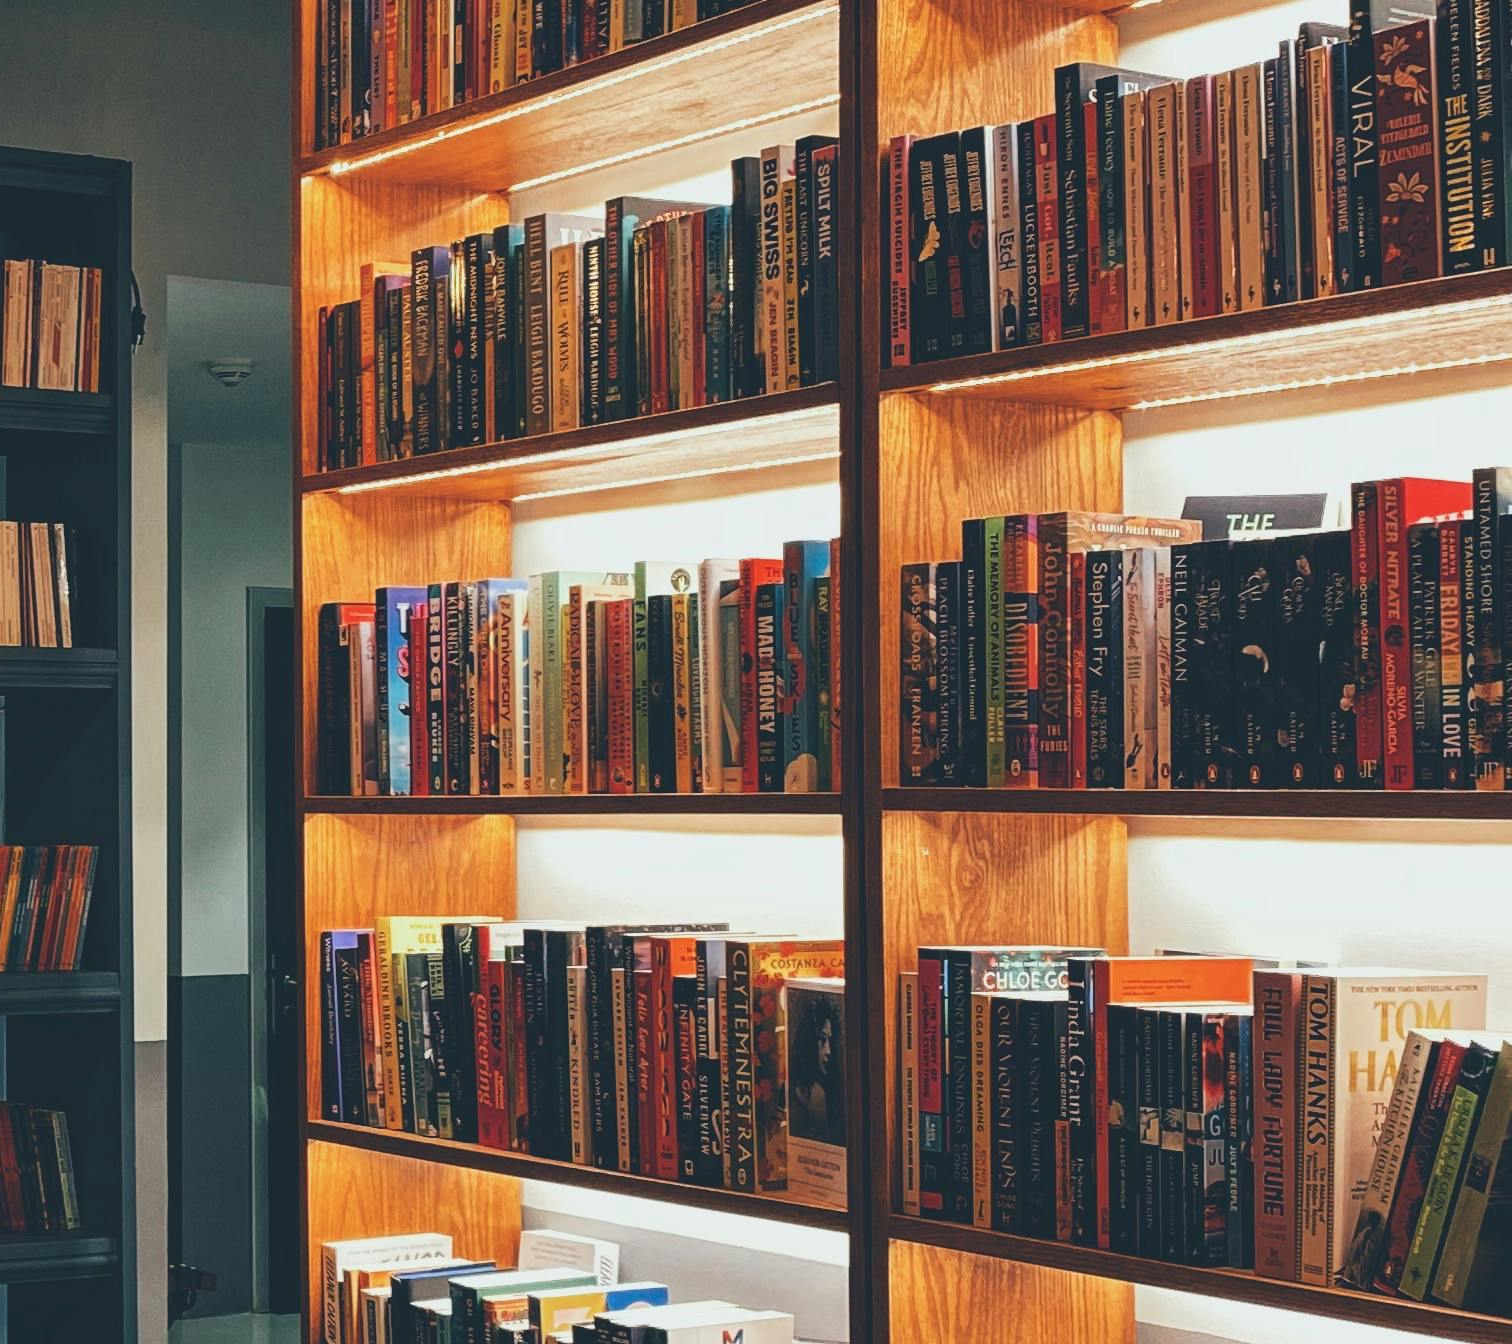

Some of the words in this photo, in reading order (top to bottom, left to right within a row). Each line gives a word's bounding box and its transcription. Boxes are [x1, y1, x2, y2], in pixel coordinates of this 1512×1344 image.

[1352, 76, 1375, 177] VIRAL
[763, 159, 777, 193] BIG
[1445, 117, 1476, 252] INSTITUTION
[529, 221, 541, 259] HELL
[764, 202, 779, 280] SWISS
[1024, 205, 1037, 317] LUCKENBOOTH
[530, 263, 542, 294] BENT
[531, 305, 543, 348] LEIGH
[531, 351, 544, 415] BARDUGO
[1226, 513, 1274, 531] THE
[1384, 487, 1397, 544] SILVER
[1479, 481, 1491, 559] UNTAMED
[990, 560, 998, 618] MEMORY
[1044, 542, 1062, 602] John
[1092, 562, 1109, 638] Stephen
[1176, 555, 1187, 596] NEIL
[1387, 550, 1400, 620] NITRATE
[1481, 564, 1492, 614] SHORE
[430, 597, 441, 701] BRIDGE
[446, 597, 458, 666] KILLINGLY
[758, 615, 775, 659] MAD
[991, 622, 998, 637] OF
[1175, 604, 1187, 681] GAIMAN
[1441, 586, 1460, 655] FRIDAY
[500, 615, 511, 721] Anniversary
[991, 640, 999, 702] ANIMALS
[1005, 602, 1028, 720] DISOBEDIENT
[1043, 610, 1063, 716] Connolly
[1089, 646, 1108, 677] Fry
[759, 670, 775, 733] HONEY
[1444, 689, 1460, 706] IN
[1443, 714, 1460, 758] LOVE
[984, 972, 1039, 990] CHLOE
[1069, 980, 1085, 1048] Linda
[1263, 988, 1283, 1041] FOUL
[1309, 984, 1329, 1041] TOM
[1374, 999, 1454, 1041] TOM
[733, 950, 752, 1162] CLYTEMNESTRA
[1263, 1051, 1283, 1108] LADY
[1069, 1056, 1085, 1126] Grant
[1307, 1049, 1330, 1146] HANKS
[1264, 1115, 1284, 1216] FORTUNE
